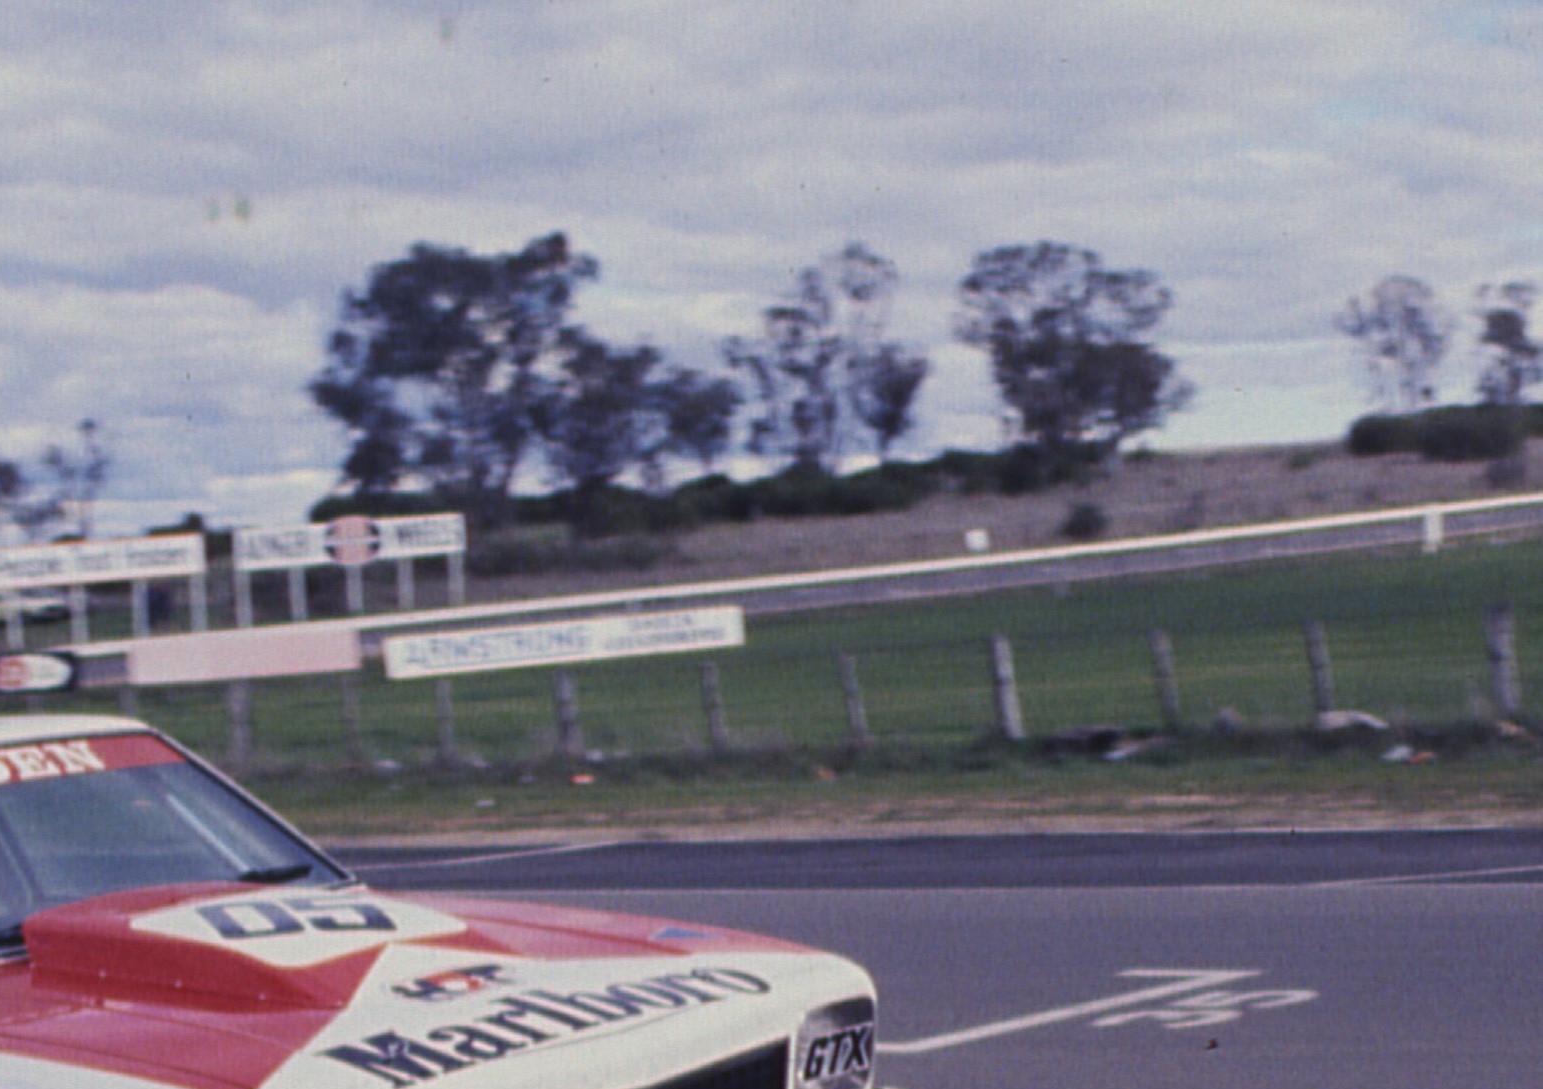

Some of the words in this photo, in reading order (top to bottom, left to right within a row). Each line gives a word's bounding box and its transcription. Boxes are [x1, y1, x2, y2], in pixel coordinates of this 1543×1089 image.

[196, 899, 398, 940] 05
[313, 966, 772, 1089] Marlboro
[803, 1021, 873, 1082] GTX
